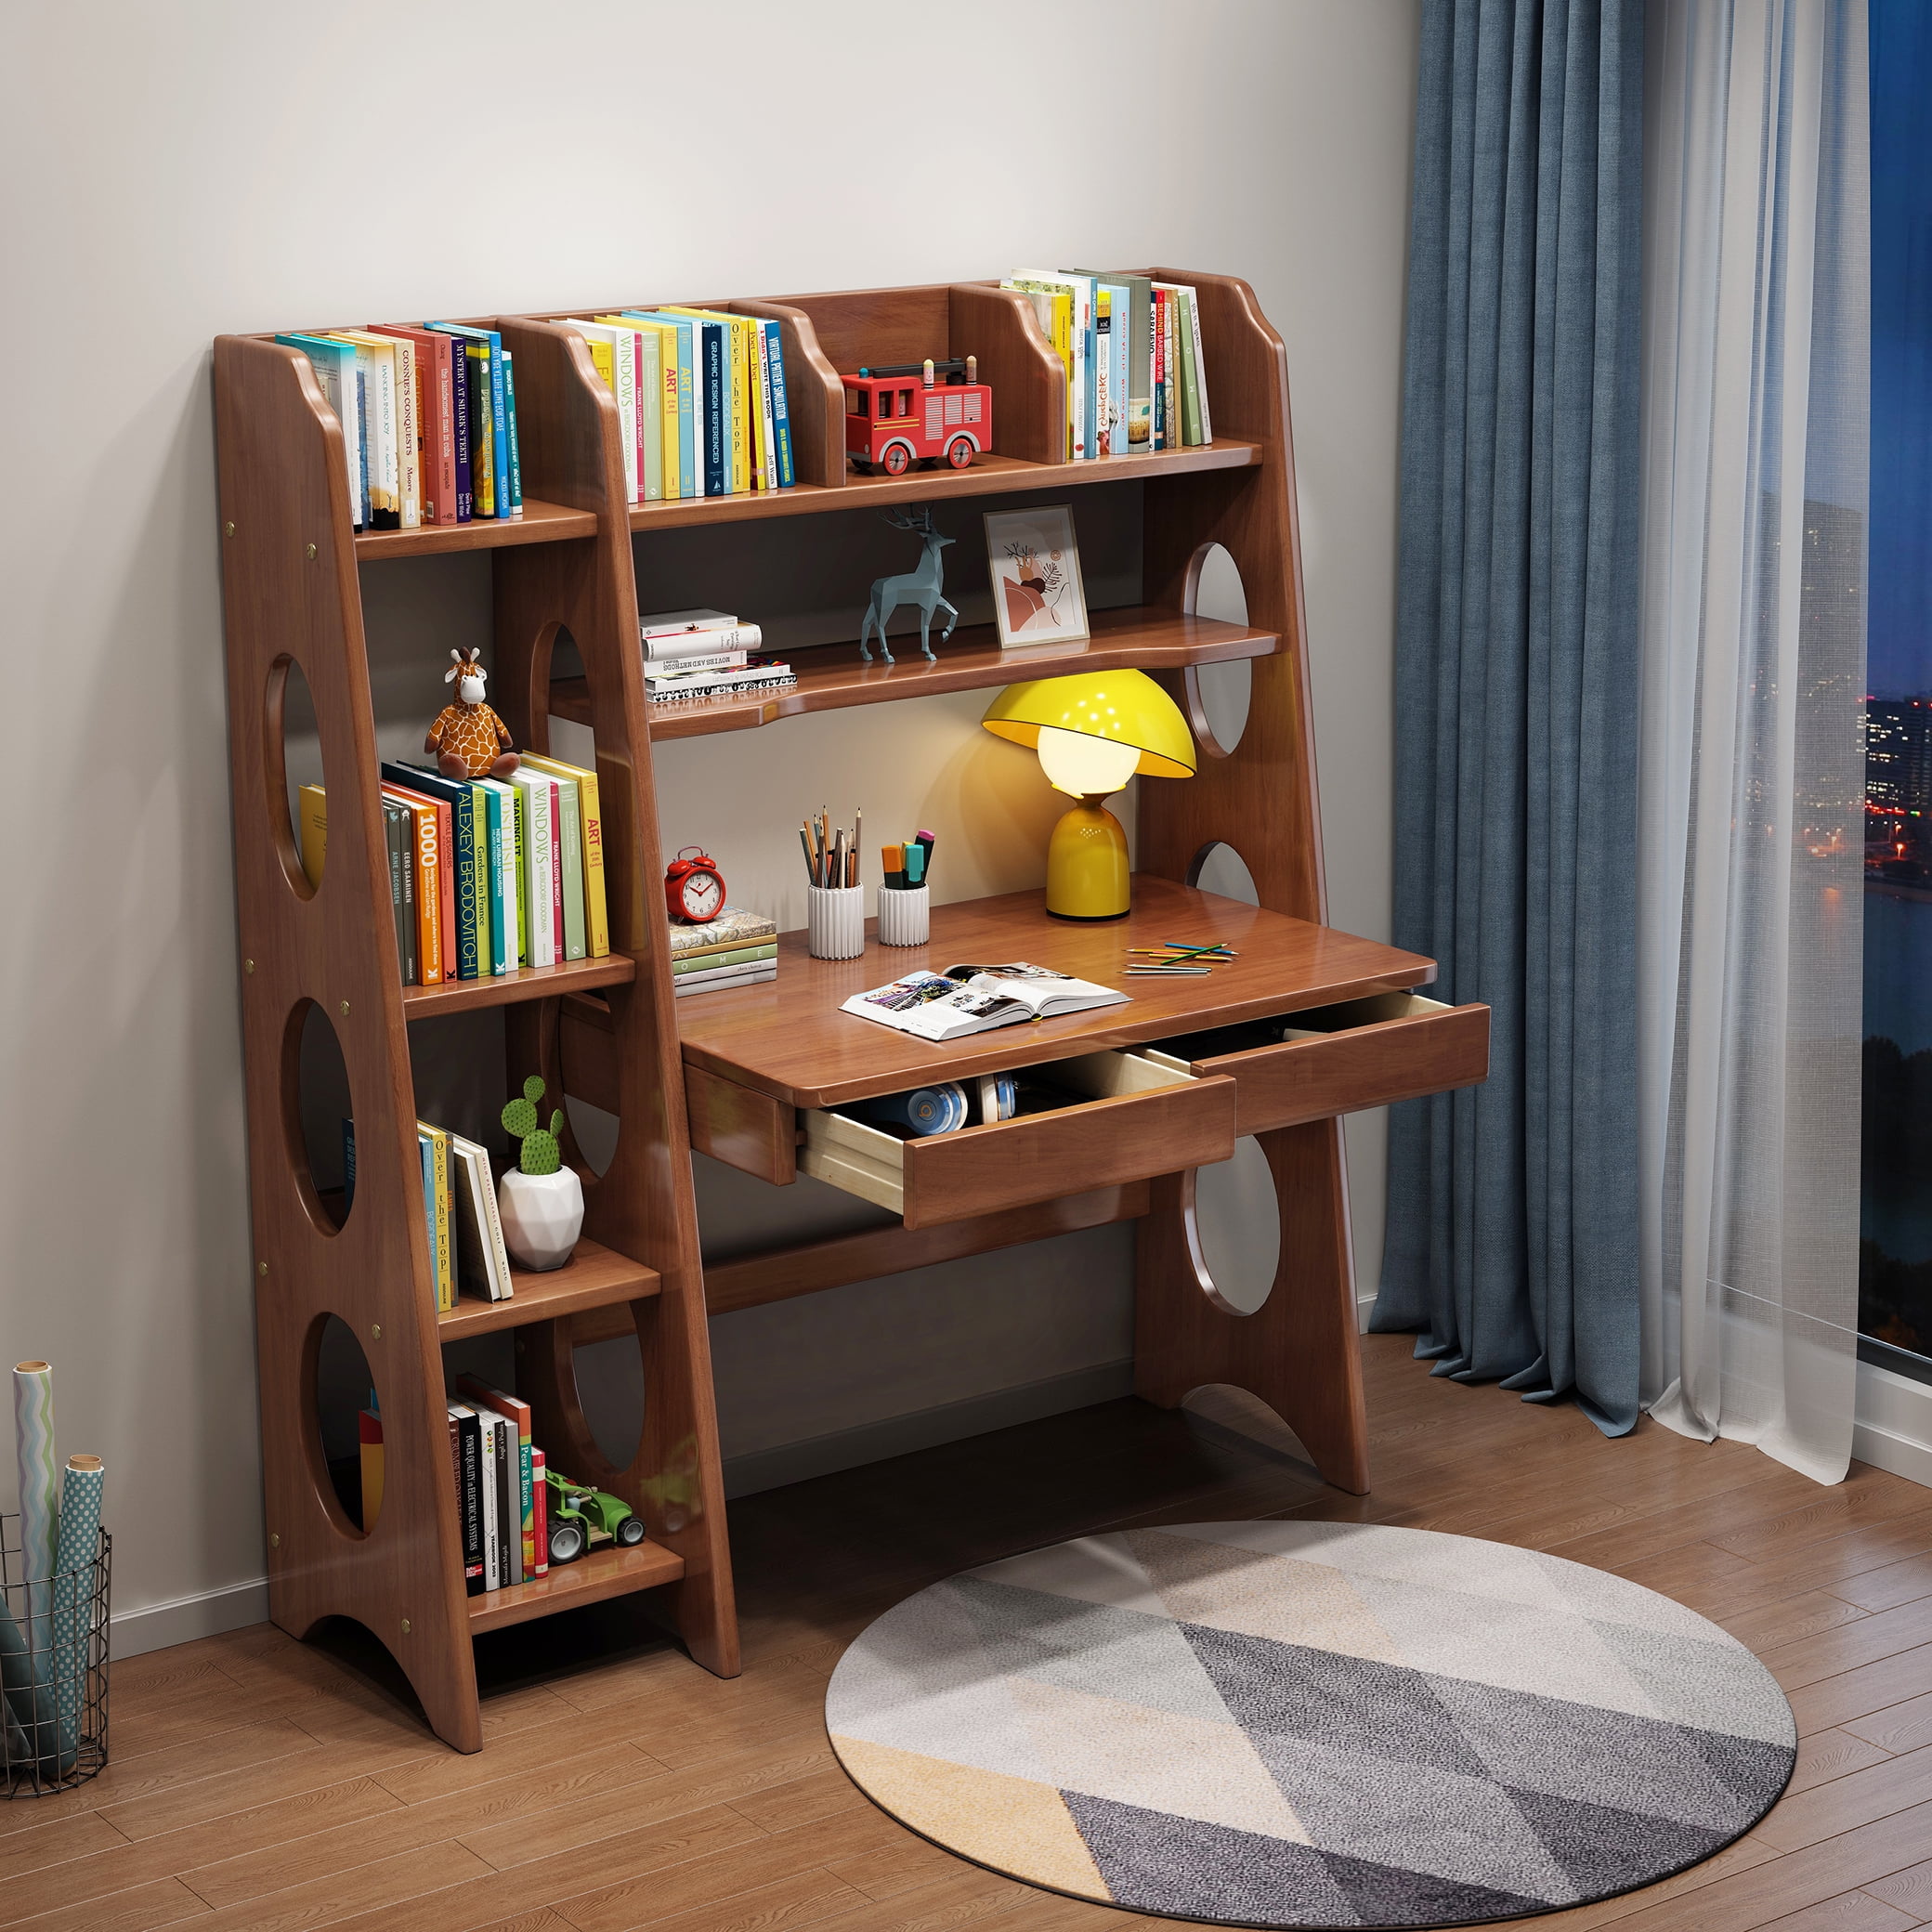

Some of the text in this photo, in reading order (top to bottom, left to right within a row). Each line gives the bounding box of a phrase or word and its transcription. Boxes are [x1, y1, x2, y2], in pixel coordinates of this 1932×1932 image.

[732, 323, 740, 364] Over
[768, 336, 781, 363] VIRTUAL
[440, 368, 449, 379] the
[620, 335, 633, 407] WINDOWS
[666, 368, 677, 395] ART
[681, 367, 691, 394] ART
[771, 362, 784, 386] PATIENT
[402, 349, 412, 456] CONNIE'S CONQUESTS
[441, 380, 450, 417] handsomest
[456, 345, 467, 463] MYSTERY AT SHARK'S TEETH
[481, 389, 490, 424] World
[773, 386, 787, 421] SIMULATION
[711, 411, 720, 463] REFERENCED
[663, 656, 731, 672] MOVIES AND METHODS
[420, 814, 437, 868] 1000
[458, 792, 474, 855] ALEXEY
[534, 787, 549, 864] WINDOWS
[587, 818, 600, 846] ART
[476, 846, 485, 883] Gardens
[515, 845, 521, 856] IT
[478, 885, 486, 894] in
[460, 861, 476, 968] BRODOVITCH
[540, 902, 548, 933] GOODMAN
[436, 1140, 444, 1181] Over
[438, 1234, 447, 1270] Top
[465, 1434, 475, 1456] POWER
[464, 1456, 476, 1482] QUALITY
[520, 1446, 529, 1507] Pear & Bacon
[467, 1487, 476, 1523] ELECTRICAL
[469, 1524, 477, 1550] SYSTEMS
